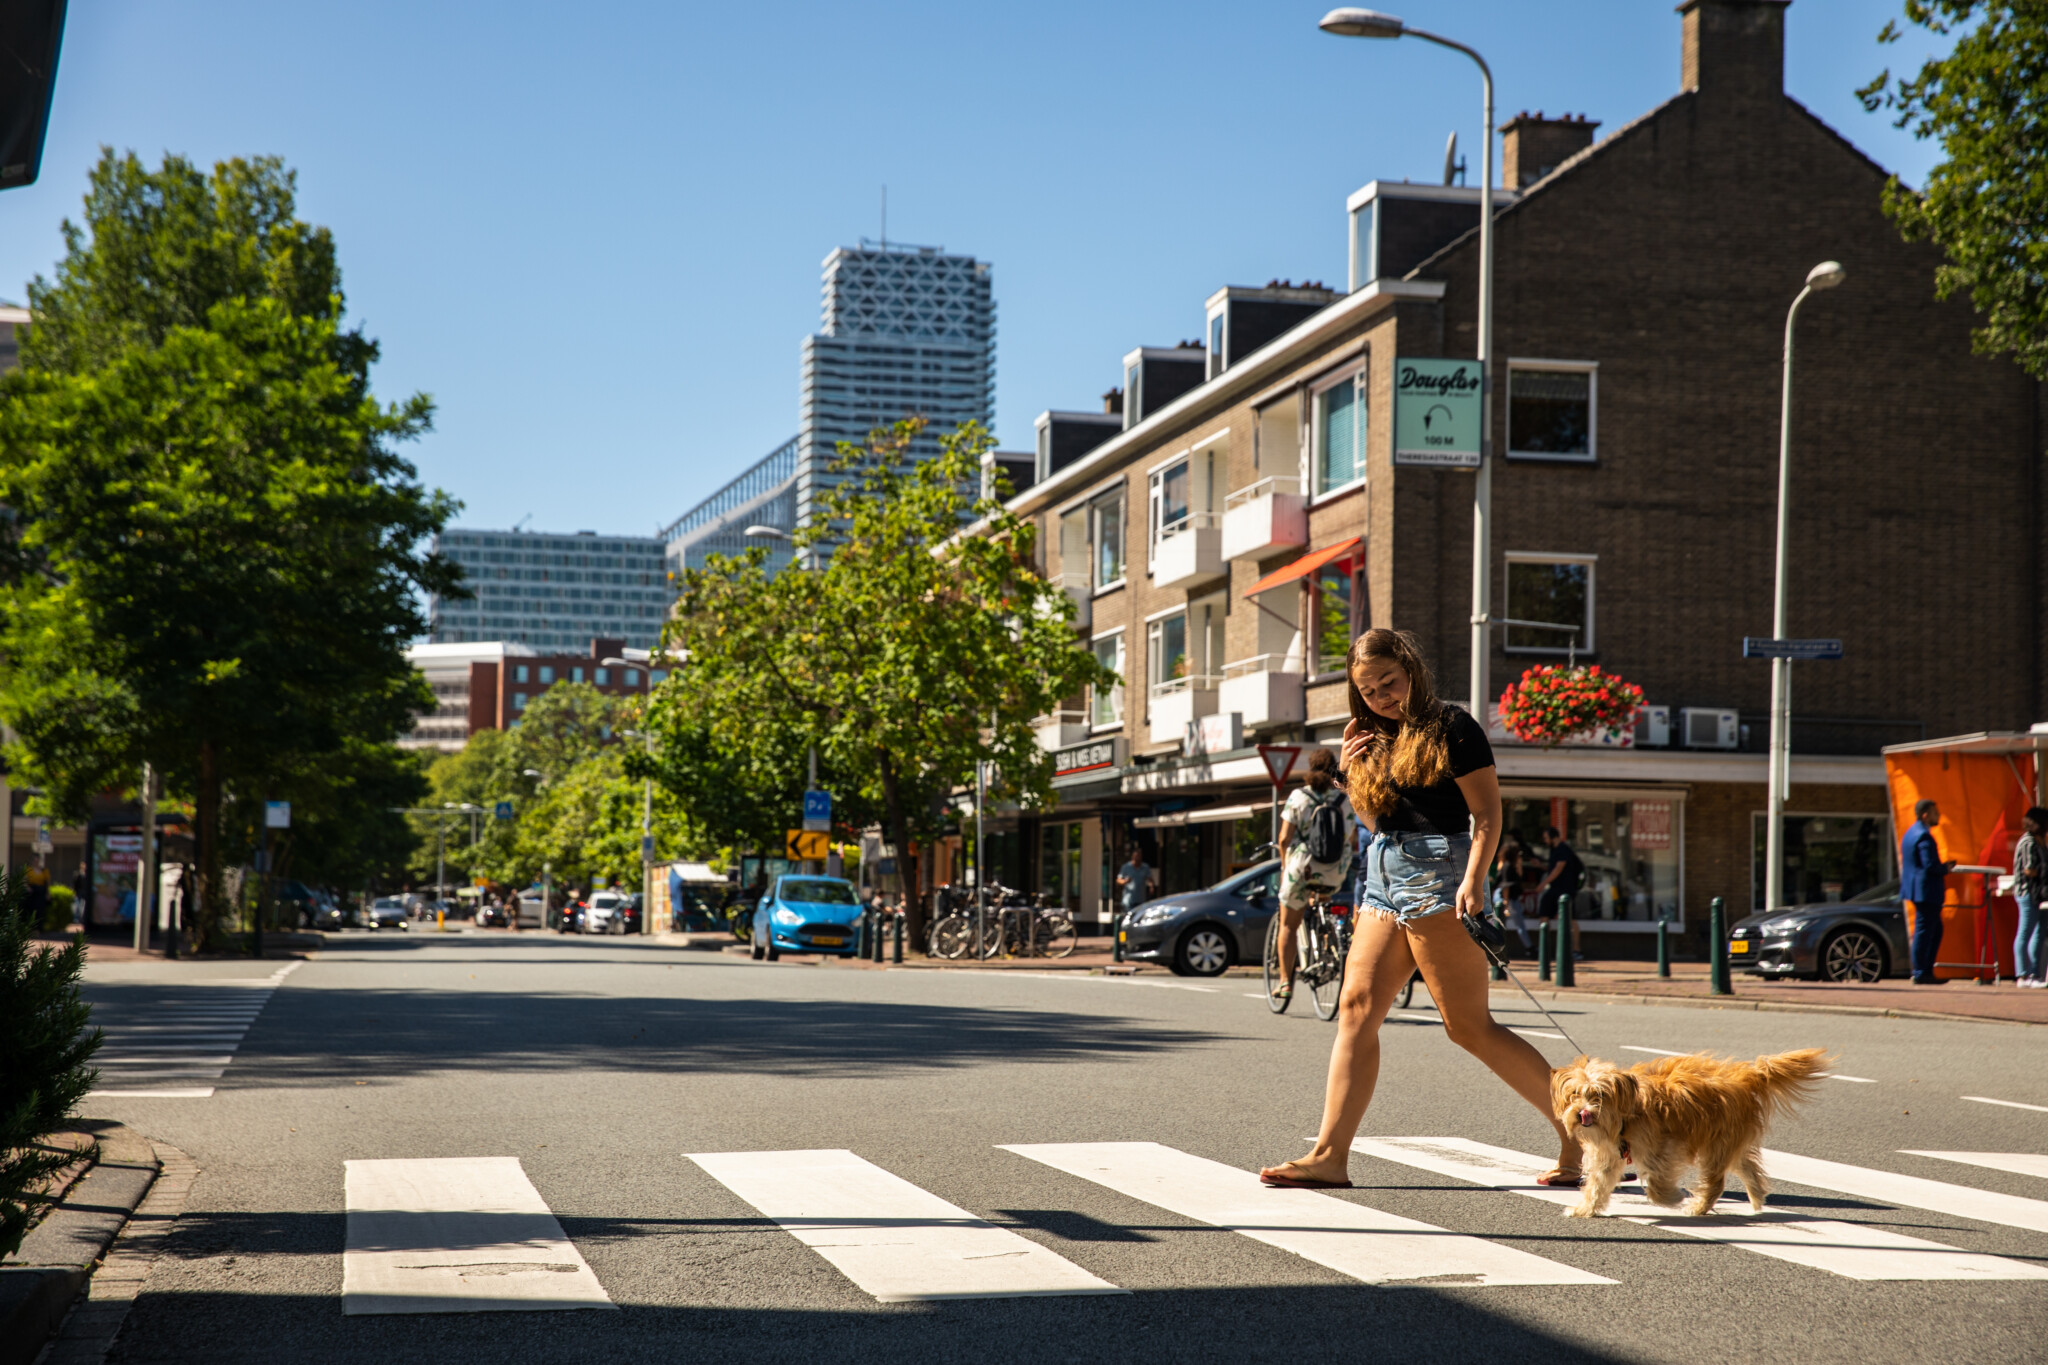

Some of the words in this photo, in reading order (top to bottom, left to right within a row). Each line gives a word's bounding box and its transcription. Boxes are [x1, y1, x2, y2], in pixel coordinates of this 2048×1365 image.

[1399, 366, 1480, 396] Douglas
[1425, 436, 1442, 445] 100
[1444, 436, 1454, 445] M
[1398, 453, 1462, 462] THERESIASTRAAT
